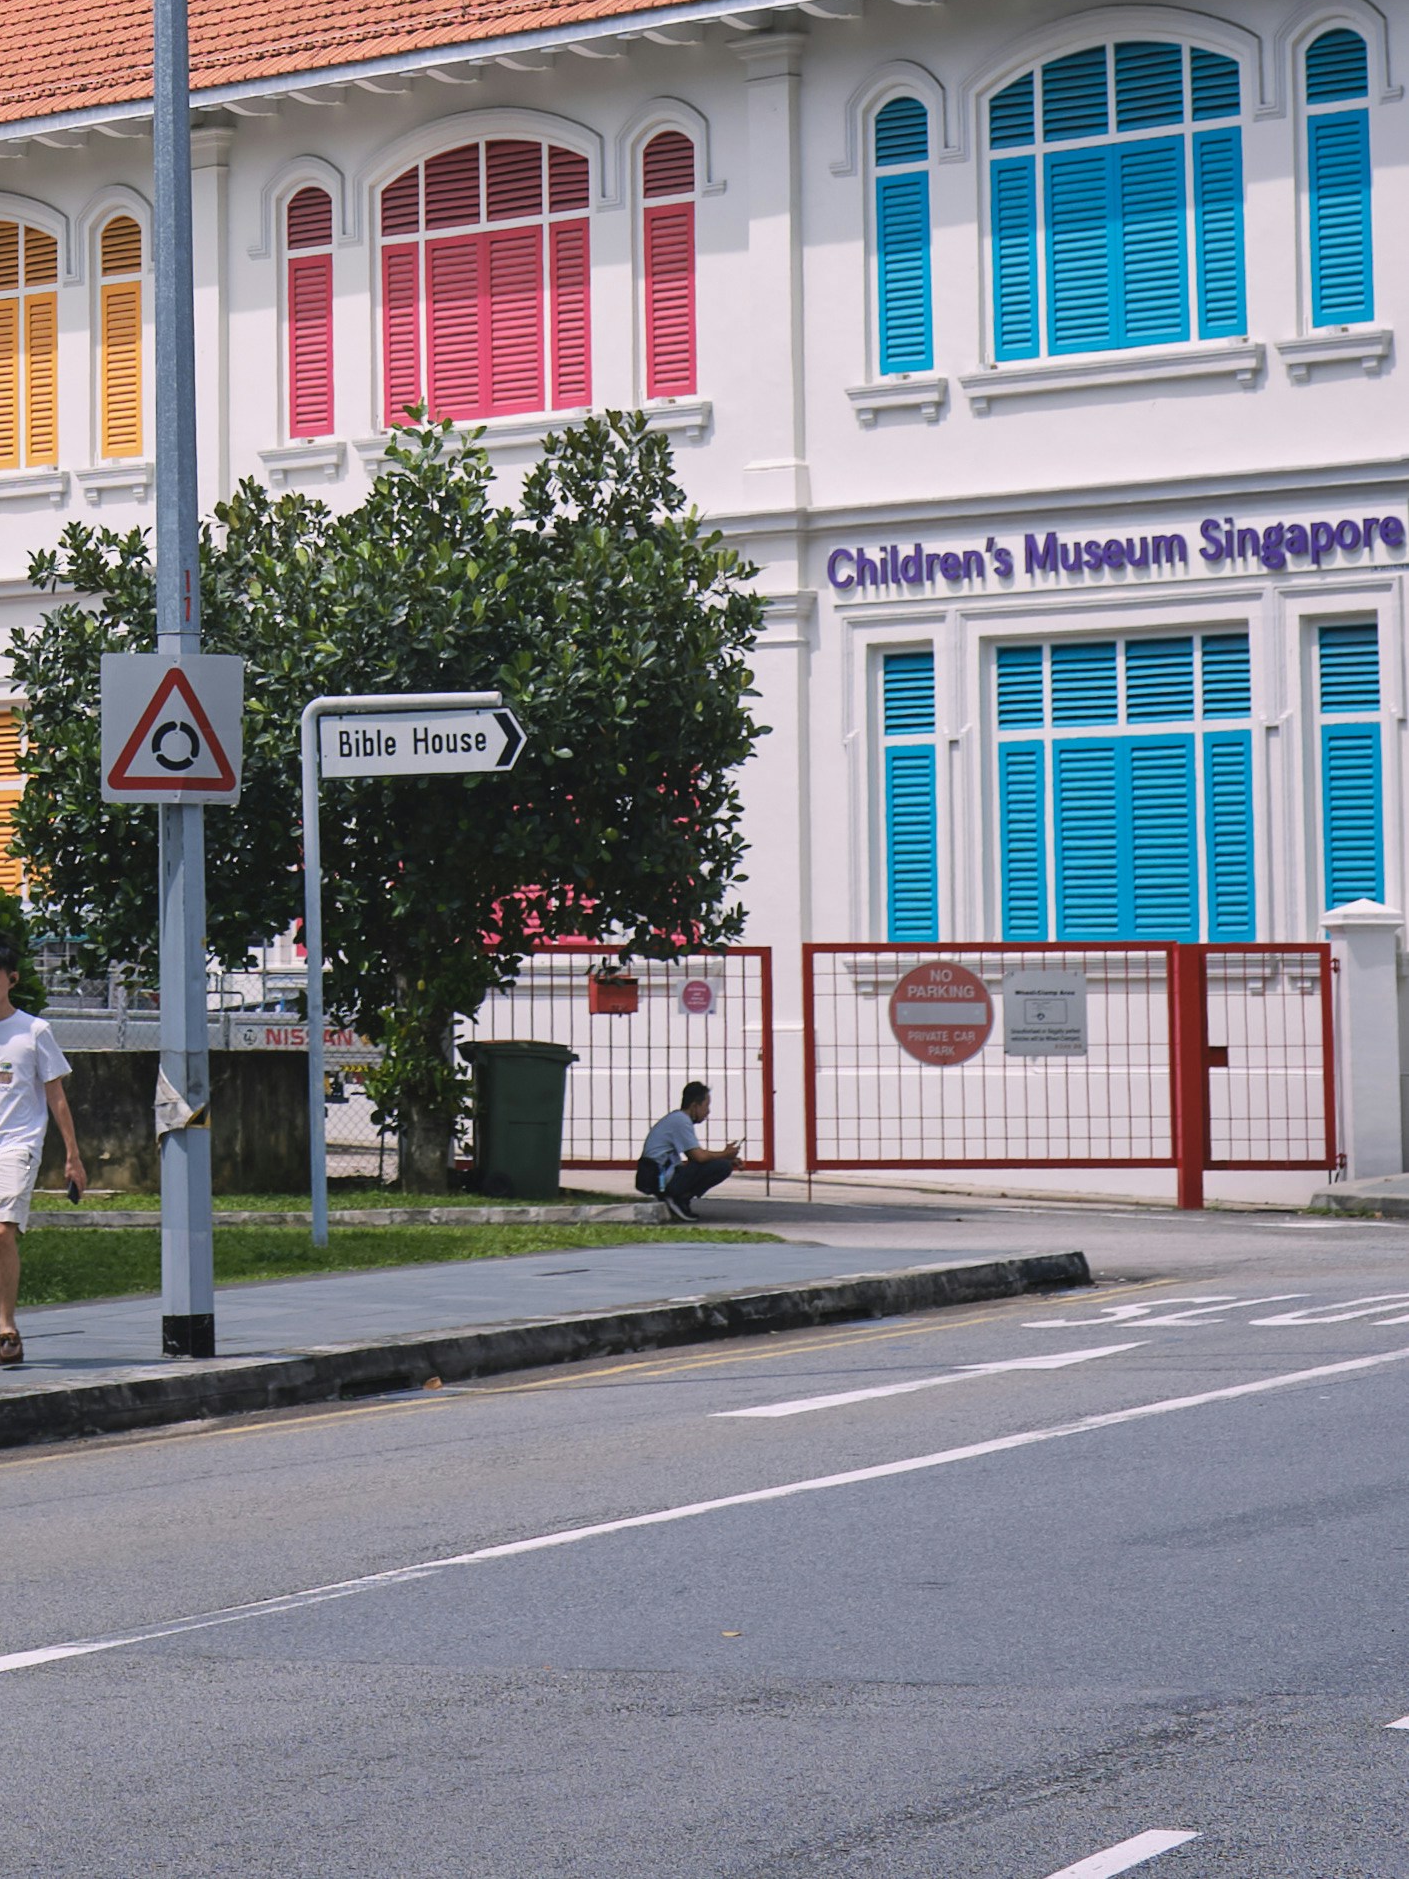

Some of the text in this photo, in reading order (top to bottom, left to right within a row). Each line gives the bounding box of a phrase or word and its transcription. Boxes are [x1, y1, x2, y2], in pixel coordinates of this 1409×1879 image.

[827, 515, 1406, 590] Children's Museum Singapore
[338, 727, 487, 758] Bible House
[929, 969, 953, 982] NO
[907, 985, 975, 998] PARKING
[265, 1028, 353, 1046] NISAN
[907, 1030, 976, 1042] PRIVATE CAR
[927, 1045, 956, 1057] PARK
